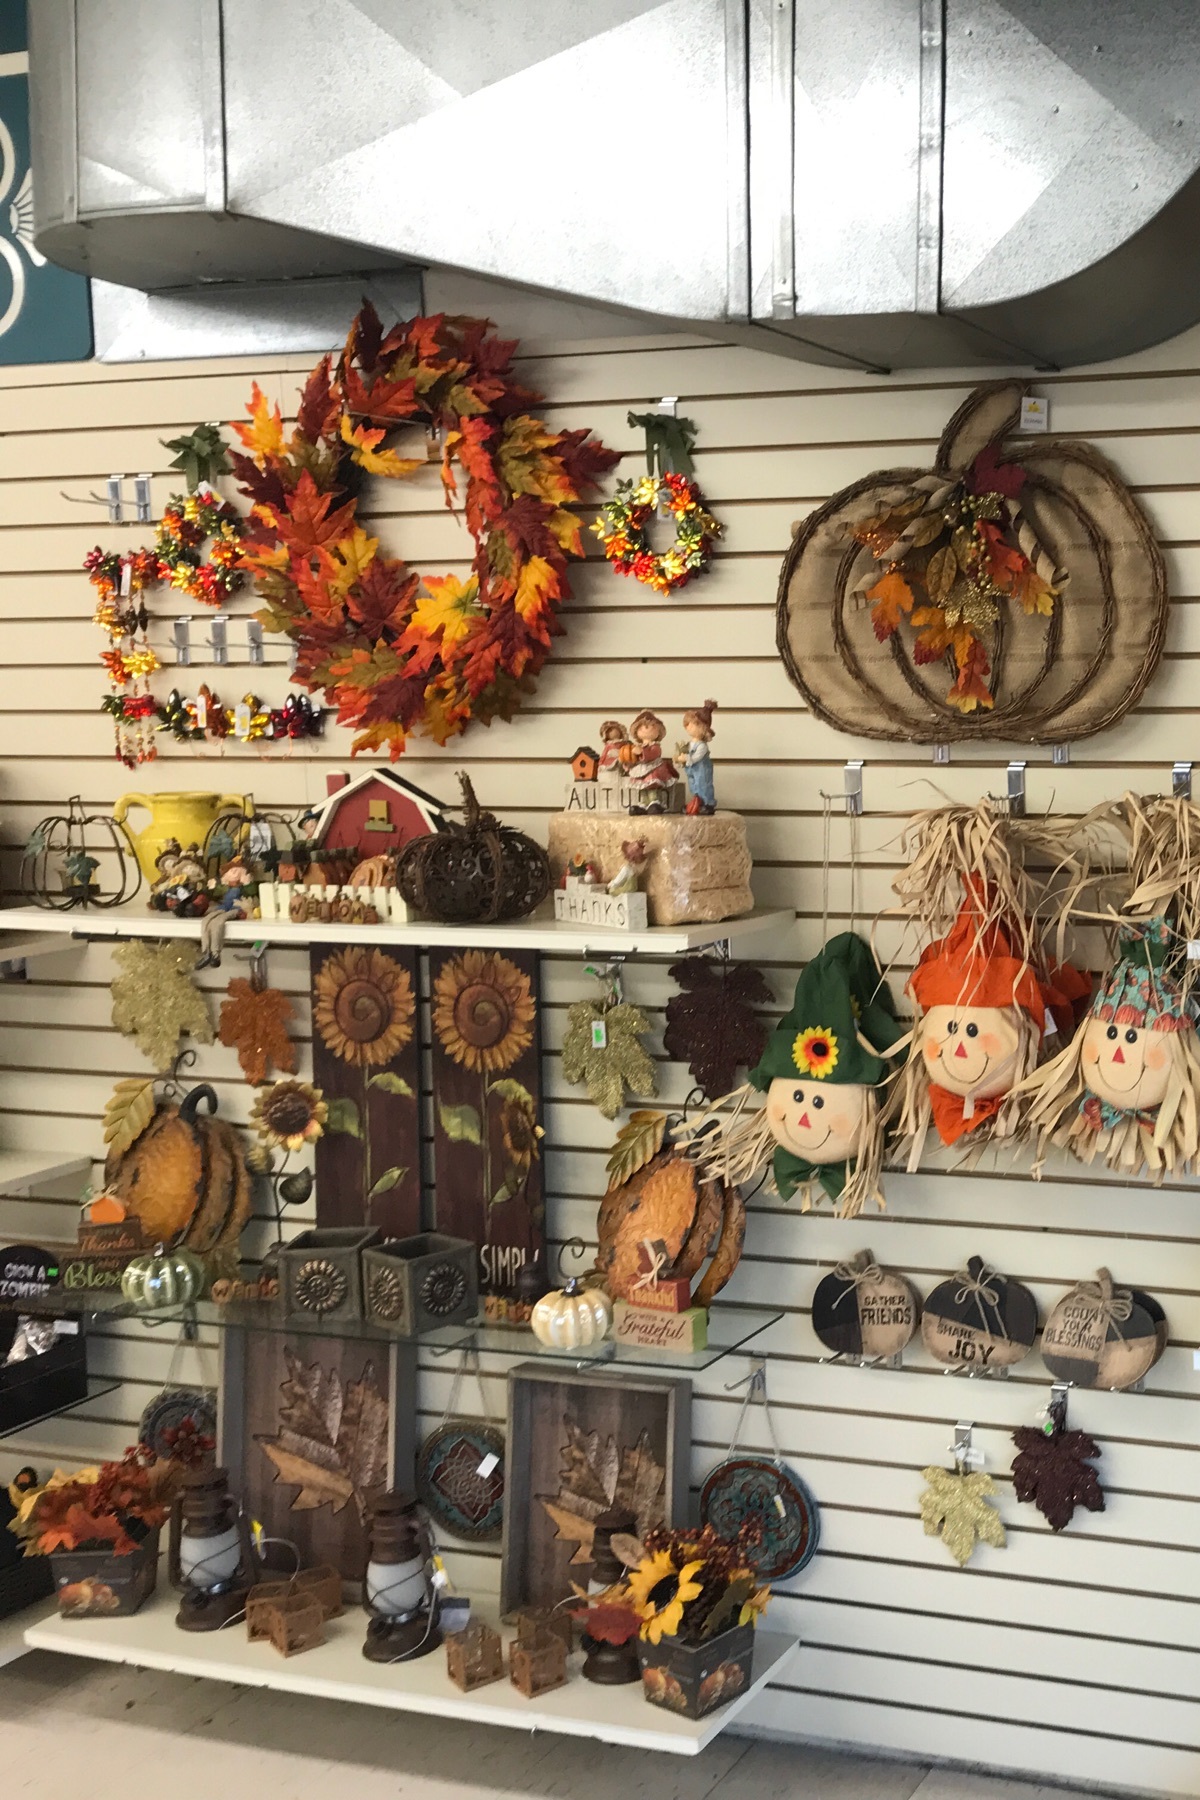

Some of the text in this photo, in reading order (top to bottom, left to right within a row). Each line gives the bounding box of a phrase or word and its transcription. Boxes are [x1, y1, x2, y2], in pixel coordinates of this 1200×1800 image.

[864, 1295, 906, 1306] GATHER
[860, 1307, 911, 1326] FRIENDS
[617, 1310, 686, 1346] Grateful
[936, 1322, 976, 1342] SHARE
[1045, 1328, 1103, 1352] BLESSINGS
[948, 1339, 996, 1365] JOY
